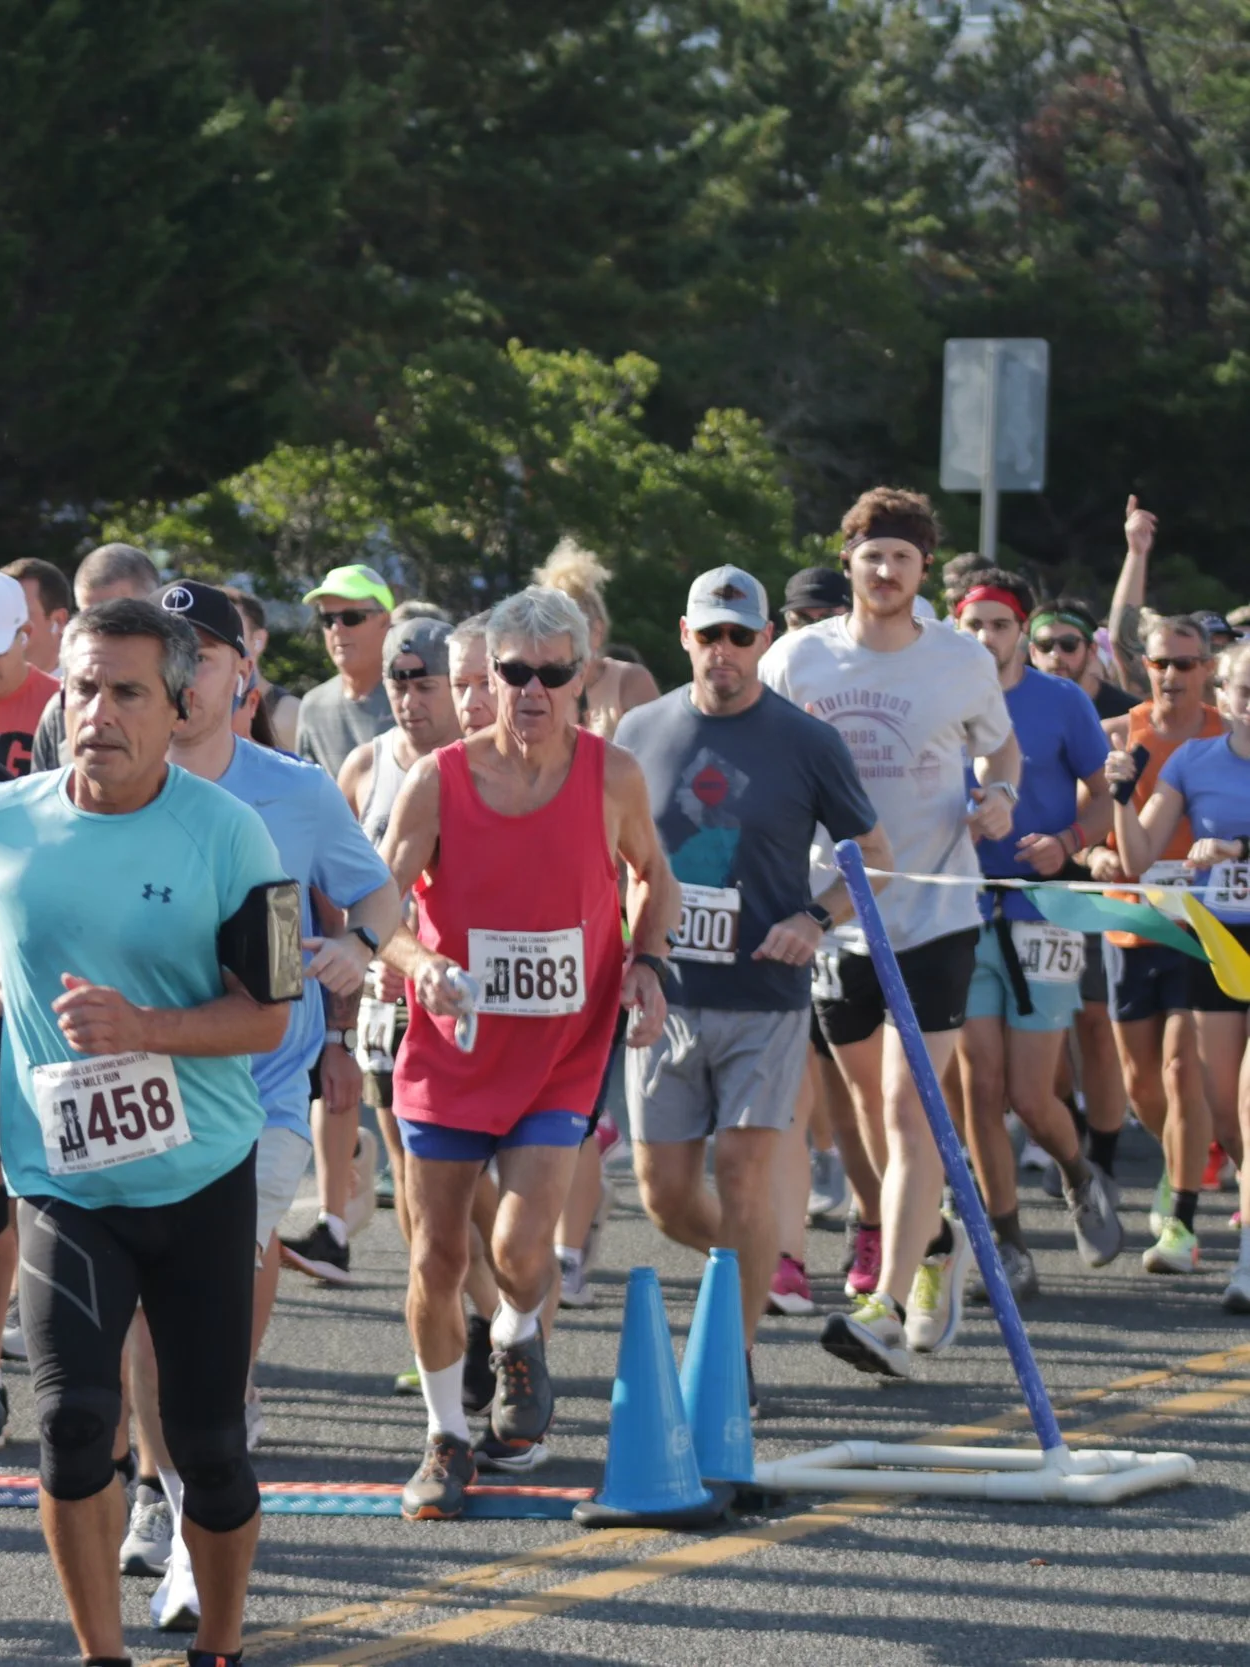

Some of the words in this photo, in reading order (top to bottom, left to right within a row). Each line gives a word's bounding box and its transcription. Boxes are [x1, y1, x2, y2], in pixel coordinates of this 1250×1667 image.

[513, 954, 578, 1001] 683
[92, 1052, 150, 1073] COMMEMORATIVE
[71, 1074, 103, 1090] 18-MILE
[103, 1071, 122, 1084] RUN
[88, 1077, 175, 1147] 458
